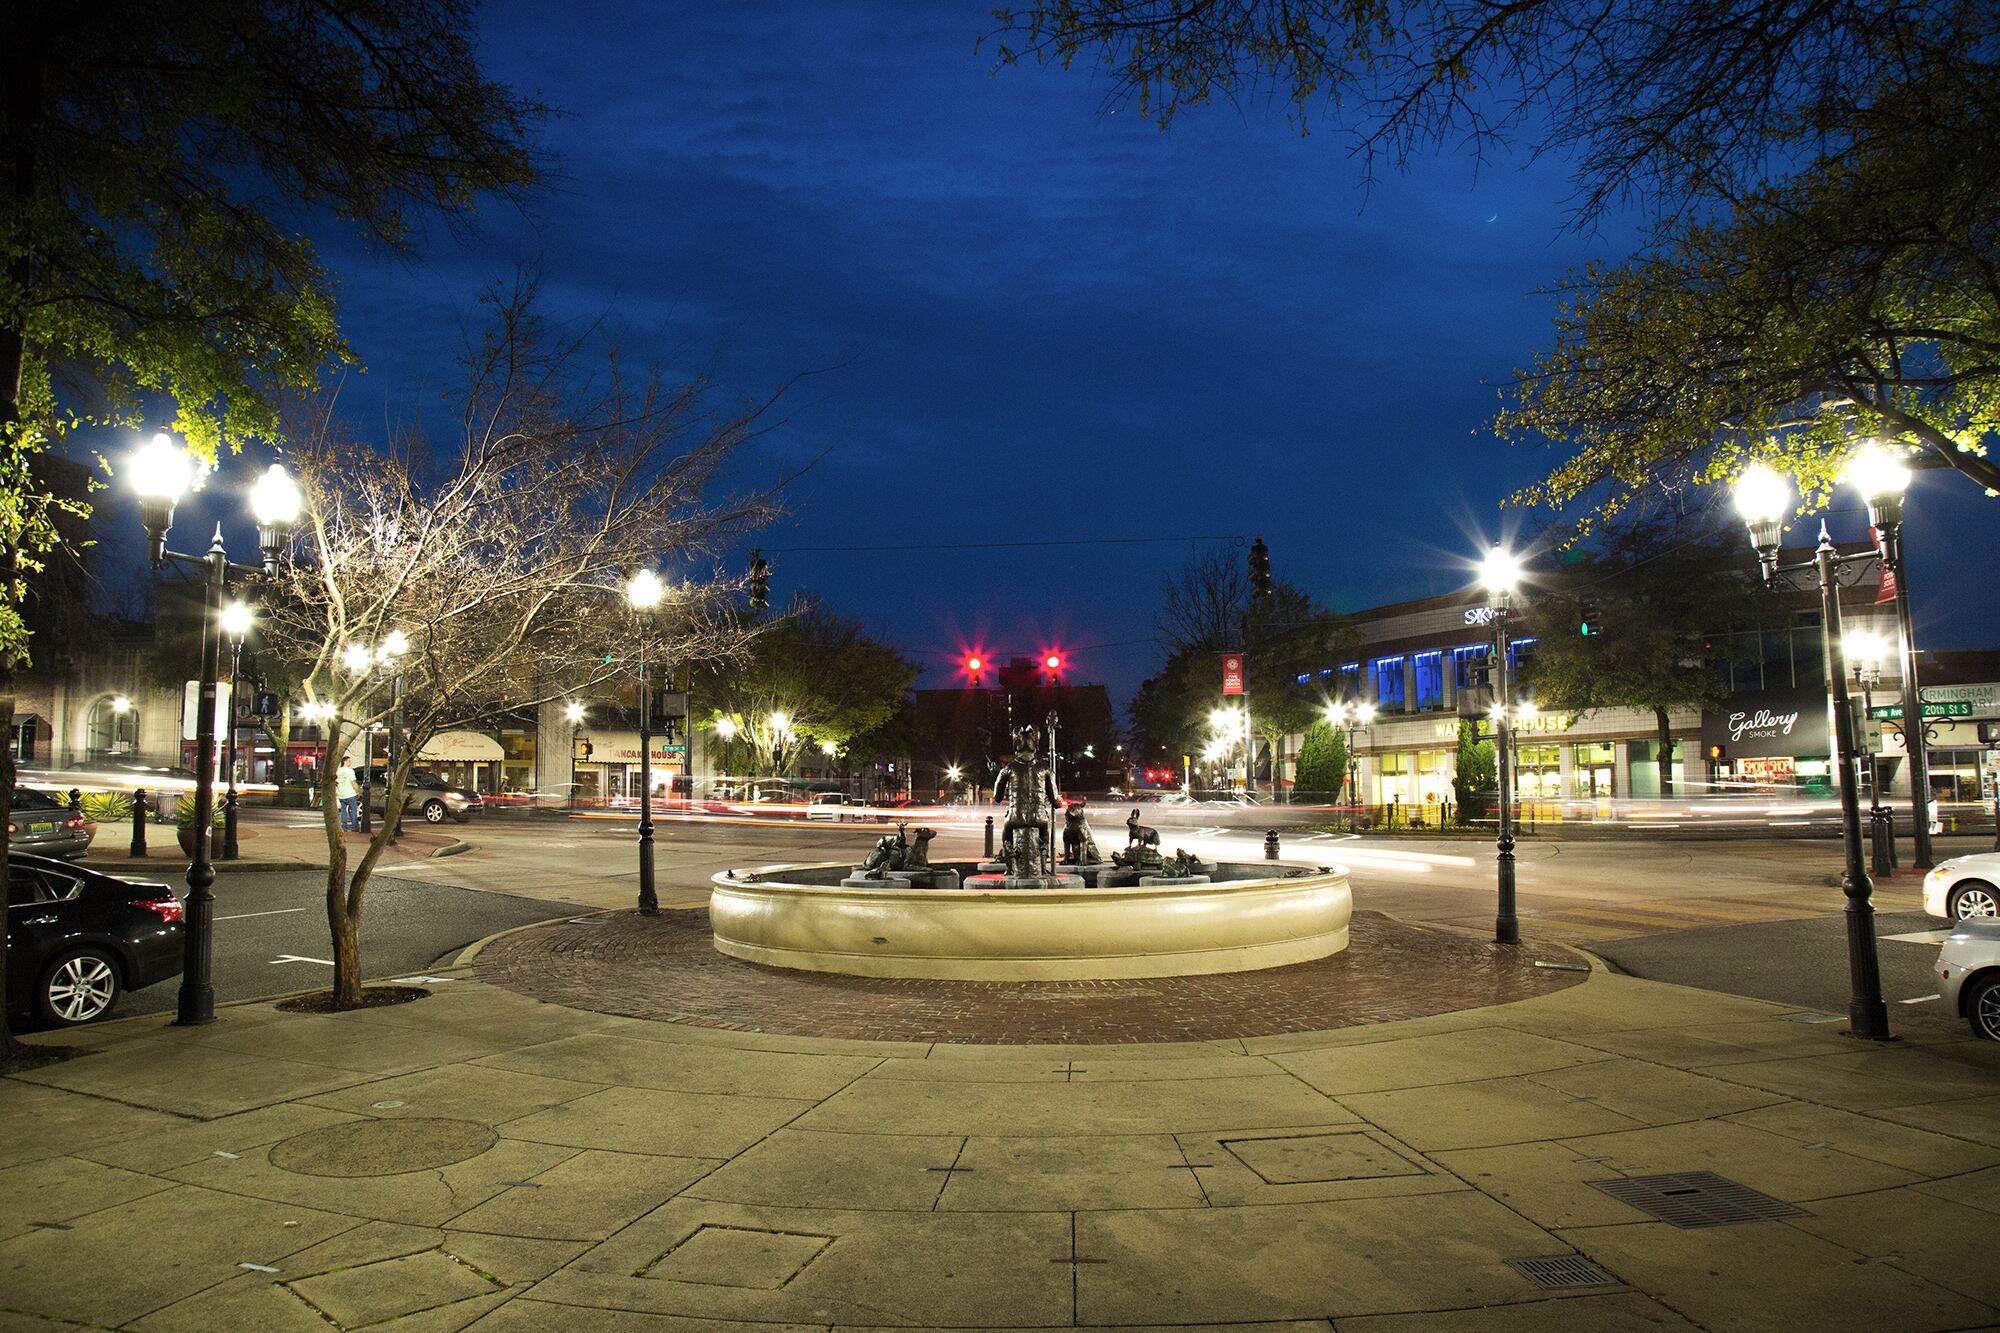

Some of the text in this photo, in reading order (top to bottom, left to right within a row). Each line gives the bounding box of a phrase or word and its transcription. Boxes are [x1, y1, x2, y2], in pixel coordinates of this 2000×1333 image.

[1890, 708, 1903, 716] Ave
[1925, 705, 1968, 715] 20th St S
[1512, 716, 1568, 731] HOUSE
[1728, 709, 1798, 741] Gallery
[1749, 730, 1777, 738] SMOKE
[609, 750, 676, 759] ANCAK HOUSE
[1744, 760, 1789, 774] SMOKE SHOP
